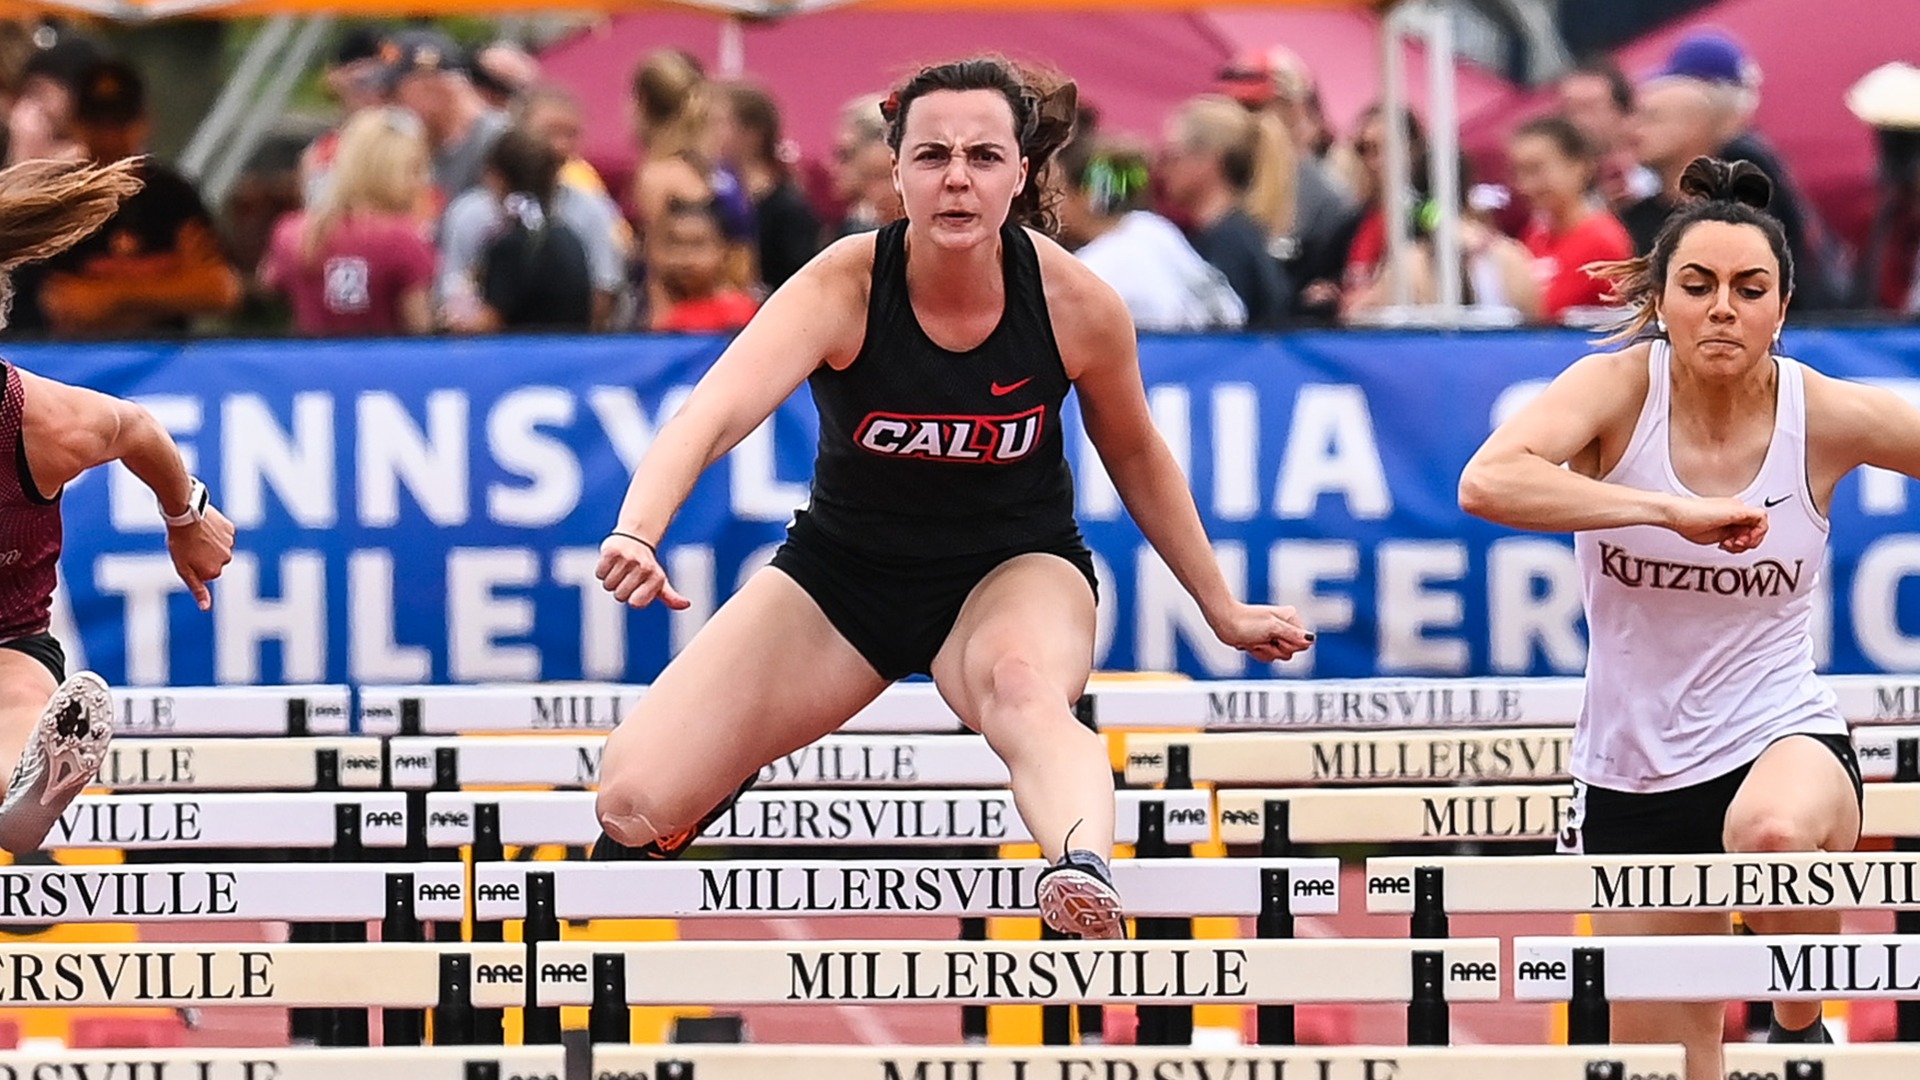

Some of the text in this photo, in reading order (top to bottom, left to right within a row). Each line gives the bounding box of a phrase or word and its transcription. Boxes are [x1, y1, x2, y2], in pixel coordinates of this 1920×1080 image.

[1597, 540, 1804, 598] KUTZTOWN
[1209, 690, 1524, 724] MILLERSVILLE
[1311, 740, 1574, 780] MILLERSVI
[699, 867, 1040, 912] MILLERSVIL
[787, 950, 1249, 1000] MILLERSVILLE
